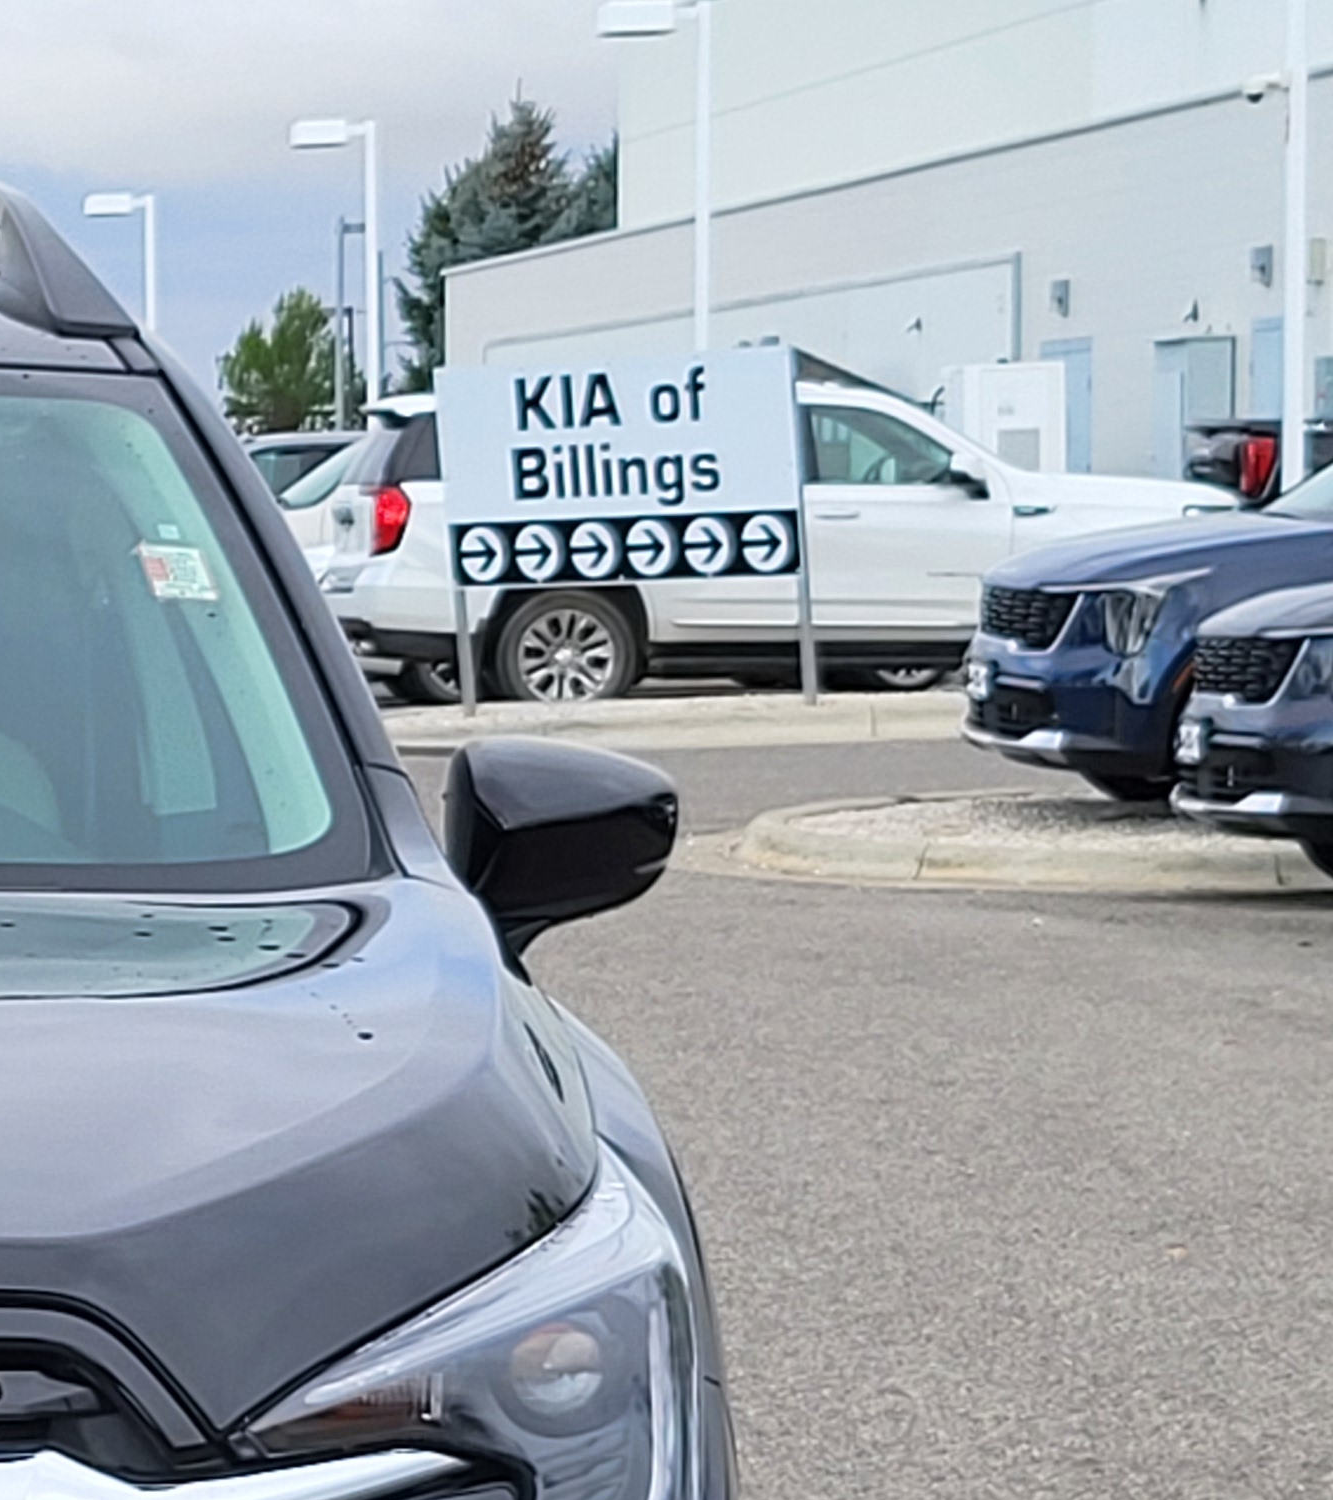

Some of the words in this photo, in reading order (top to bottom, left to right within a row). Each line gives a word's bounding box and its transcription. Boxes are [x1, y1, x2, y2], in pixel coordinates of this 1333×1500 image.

[513, 373, 622, 432] KIA
[649, 366, 706, 423] of
[510, 443, 721, 506] Billings
